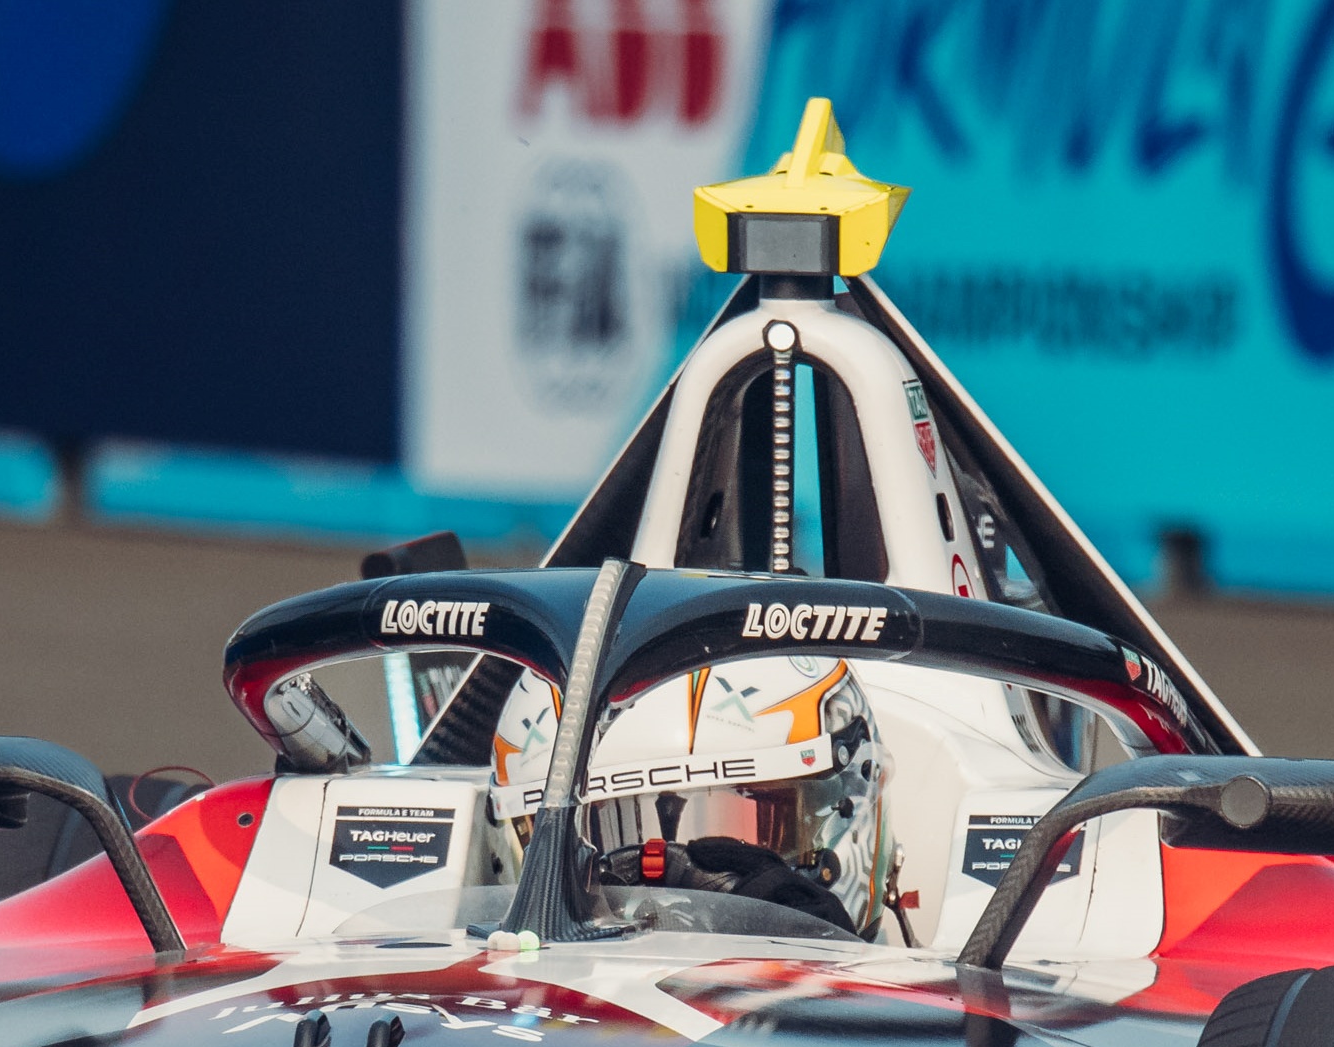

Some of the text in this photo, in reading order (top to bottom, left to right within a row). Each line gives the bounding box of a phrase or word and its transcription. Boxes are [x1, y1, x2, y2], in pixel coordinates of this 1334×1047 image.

[380, 601, 491, 637] LOCTITE
[742, 603, 889, 642] LOCTITE
[523, 758, 756, 809] PRSCHE
[358, 808, 400, 816] FORMULA
[402, 809, 408, 817] E
[990, 817, 1032, 825] FORMULA
[339, 853, 438, 864] PORSCHE
